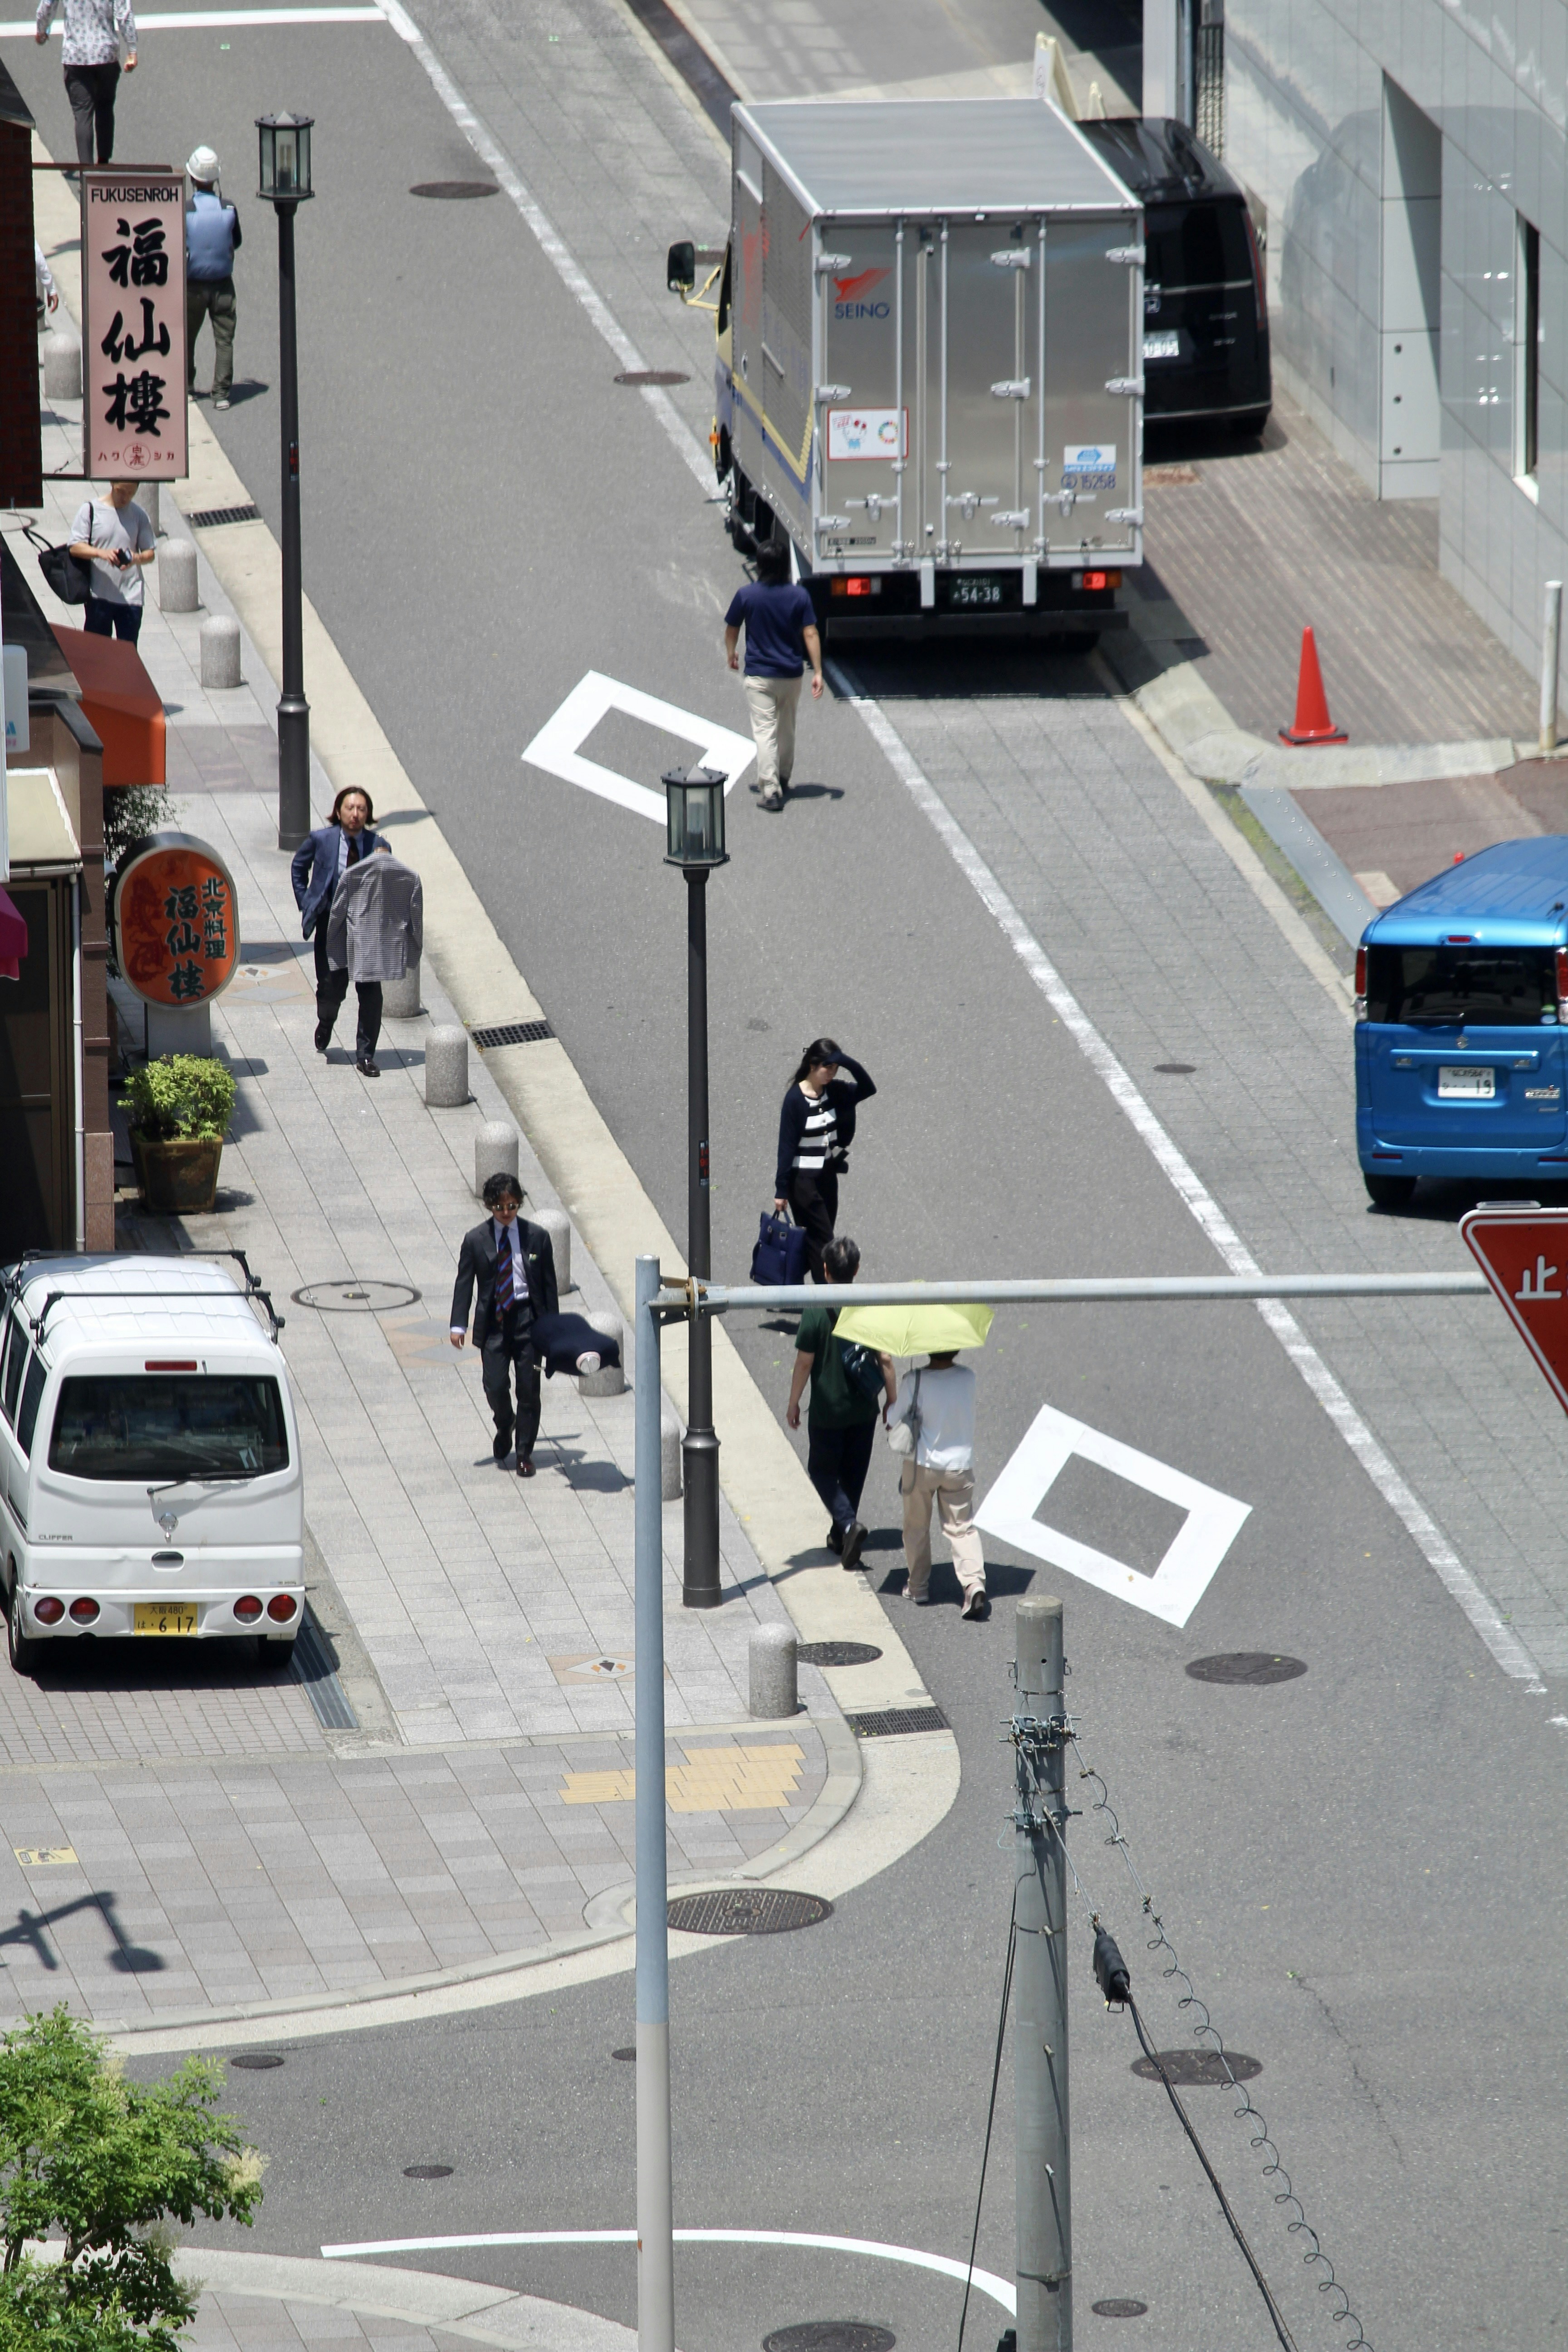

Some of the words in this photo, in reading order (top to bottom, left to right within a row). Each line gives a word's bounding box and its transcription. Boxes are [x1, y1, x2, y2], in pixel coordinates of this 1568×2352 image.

[91, 187, 178, 202] FUKUSENROH
[835, 301, 890, 319] SEINO
[1080, 474, 1116, 490] 15258
[202, 878, 226, 959] 北京料理
[168, 1606, 184, 1615] 480
[137, 1620, 146, 1629] は
